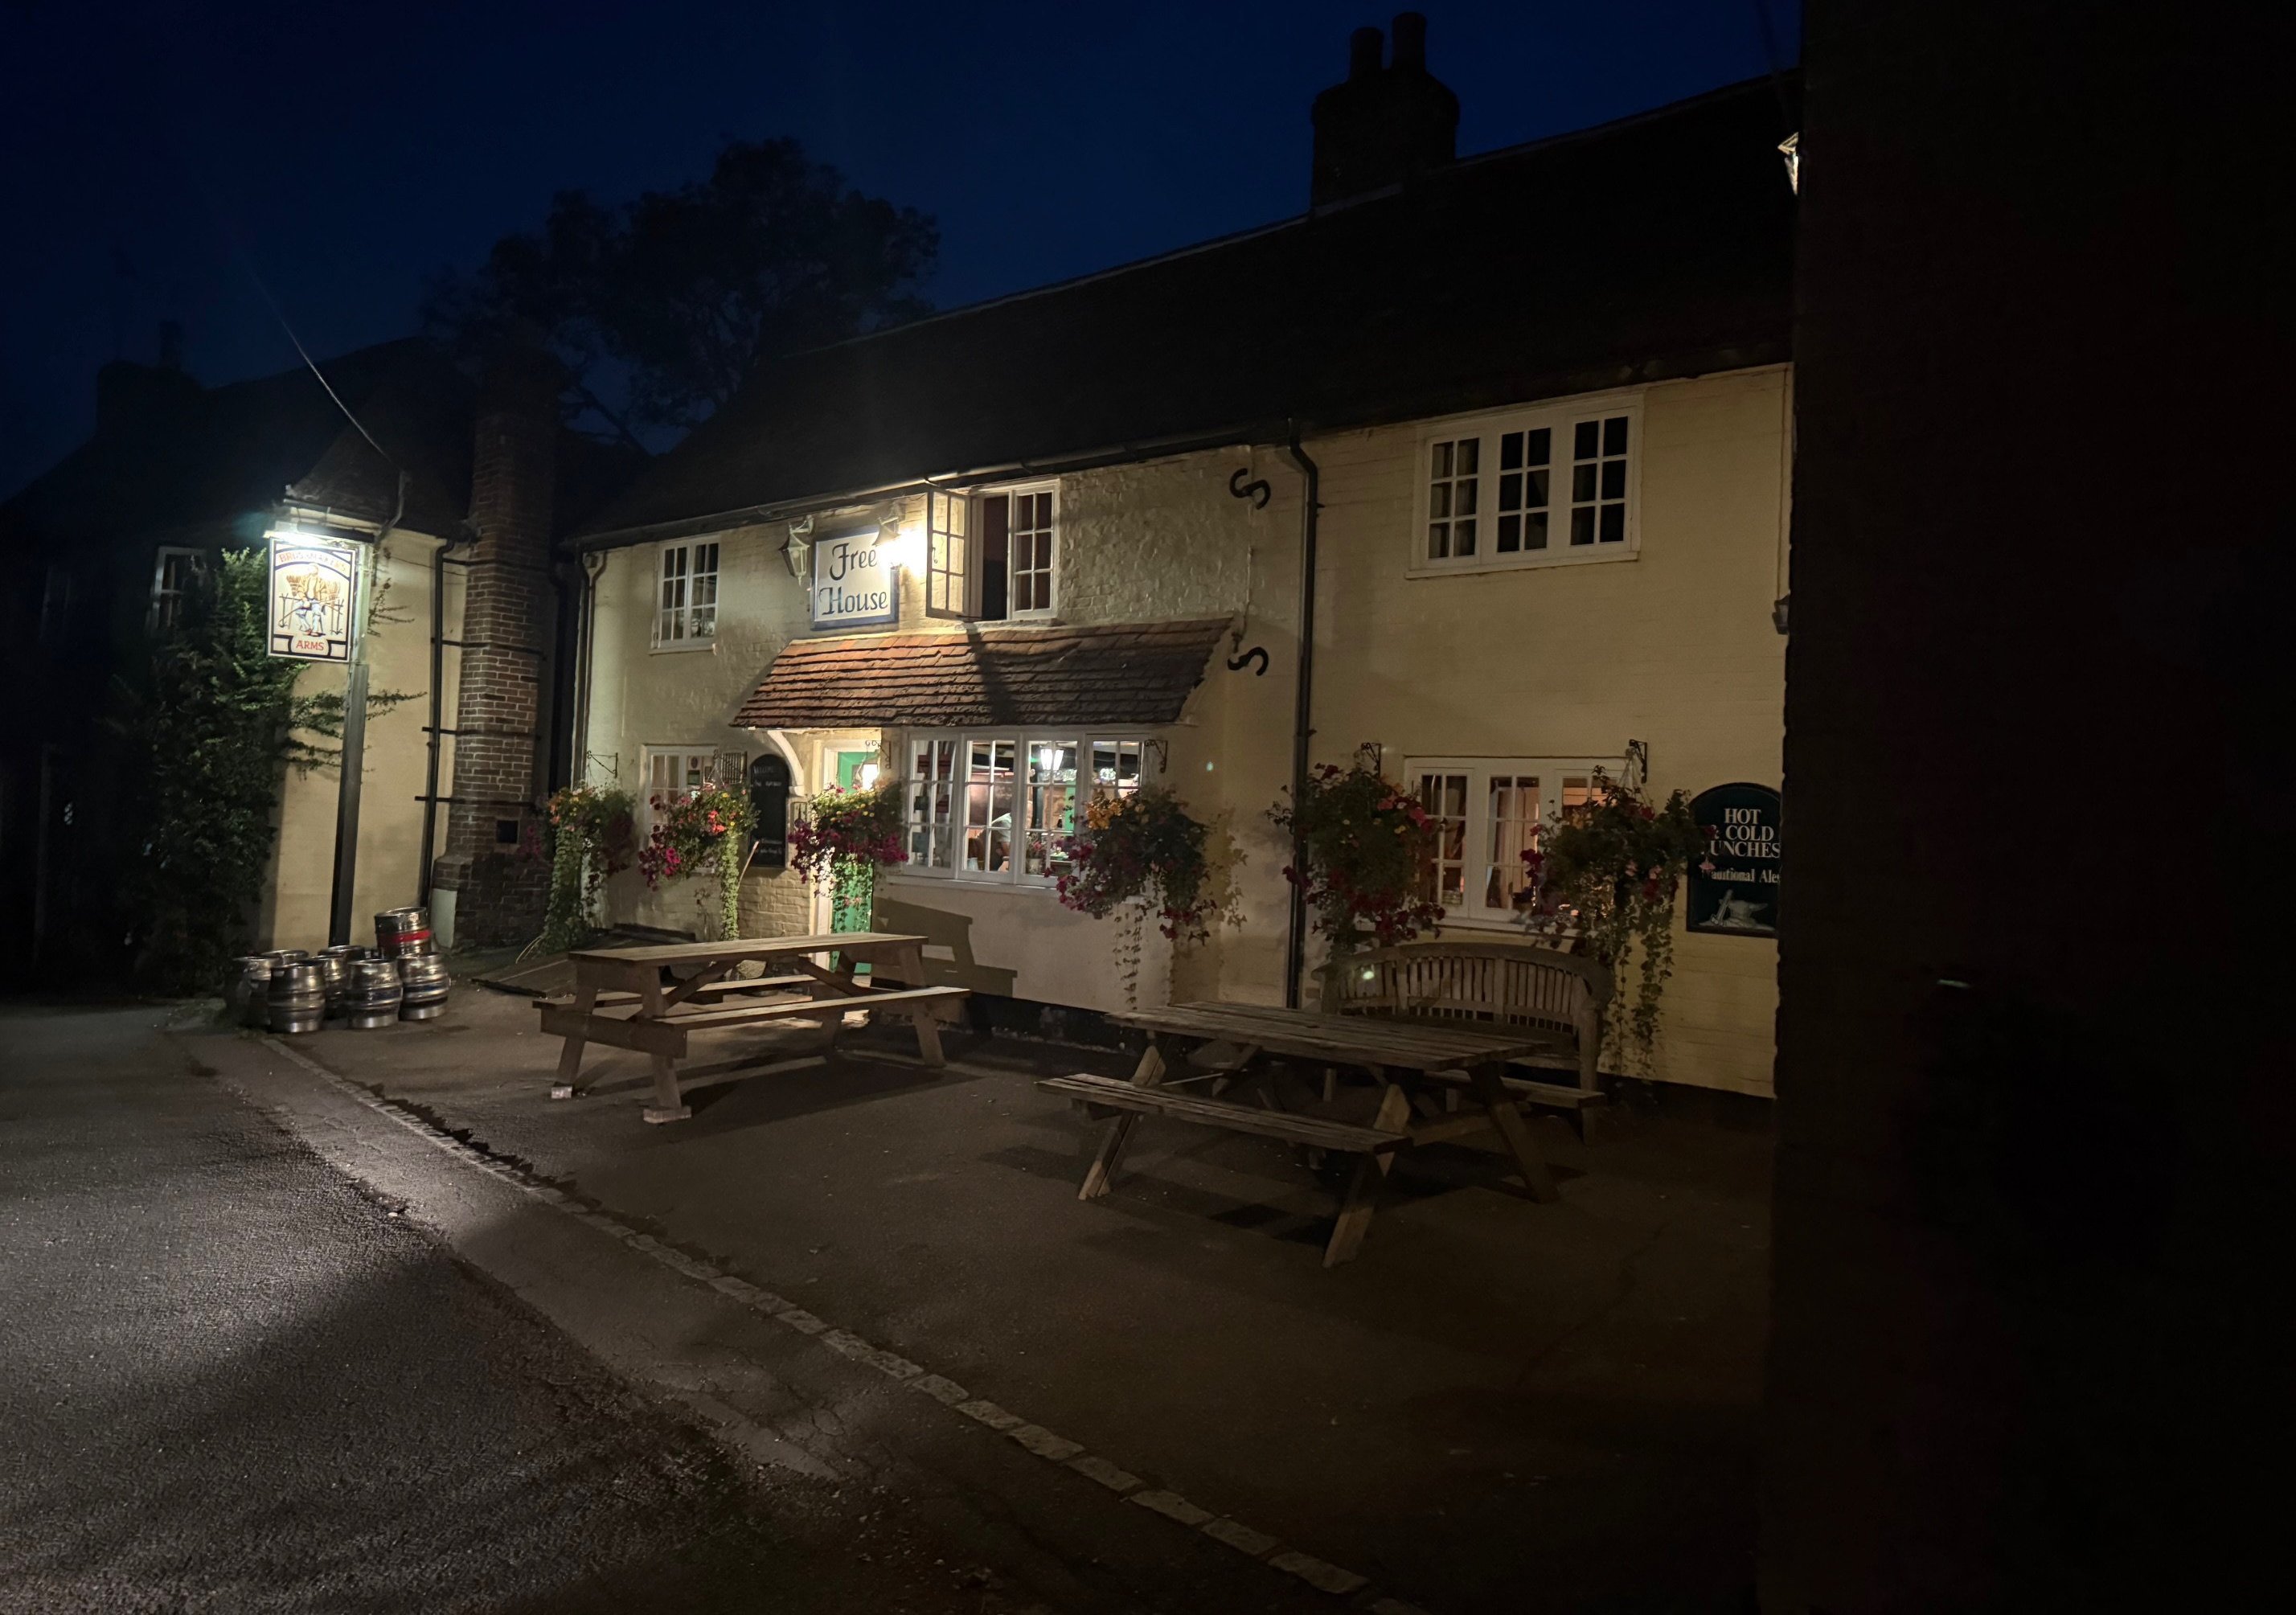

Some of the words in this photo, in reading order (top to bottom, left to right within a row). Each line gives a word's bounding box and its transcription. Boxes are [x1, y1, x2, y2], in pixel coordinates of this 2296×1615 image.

[830, 543, 878, 581] Free
[818, 586, 888, 616] House
[296, 639, 325, 651] ARMS
[1723, 807, 1762, 825] HOT
[1724, 825, 1775, 842] COLD
[1709, 839, 1781, 859] UNCHES
